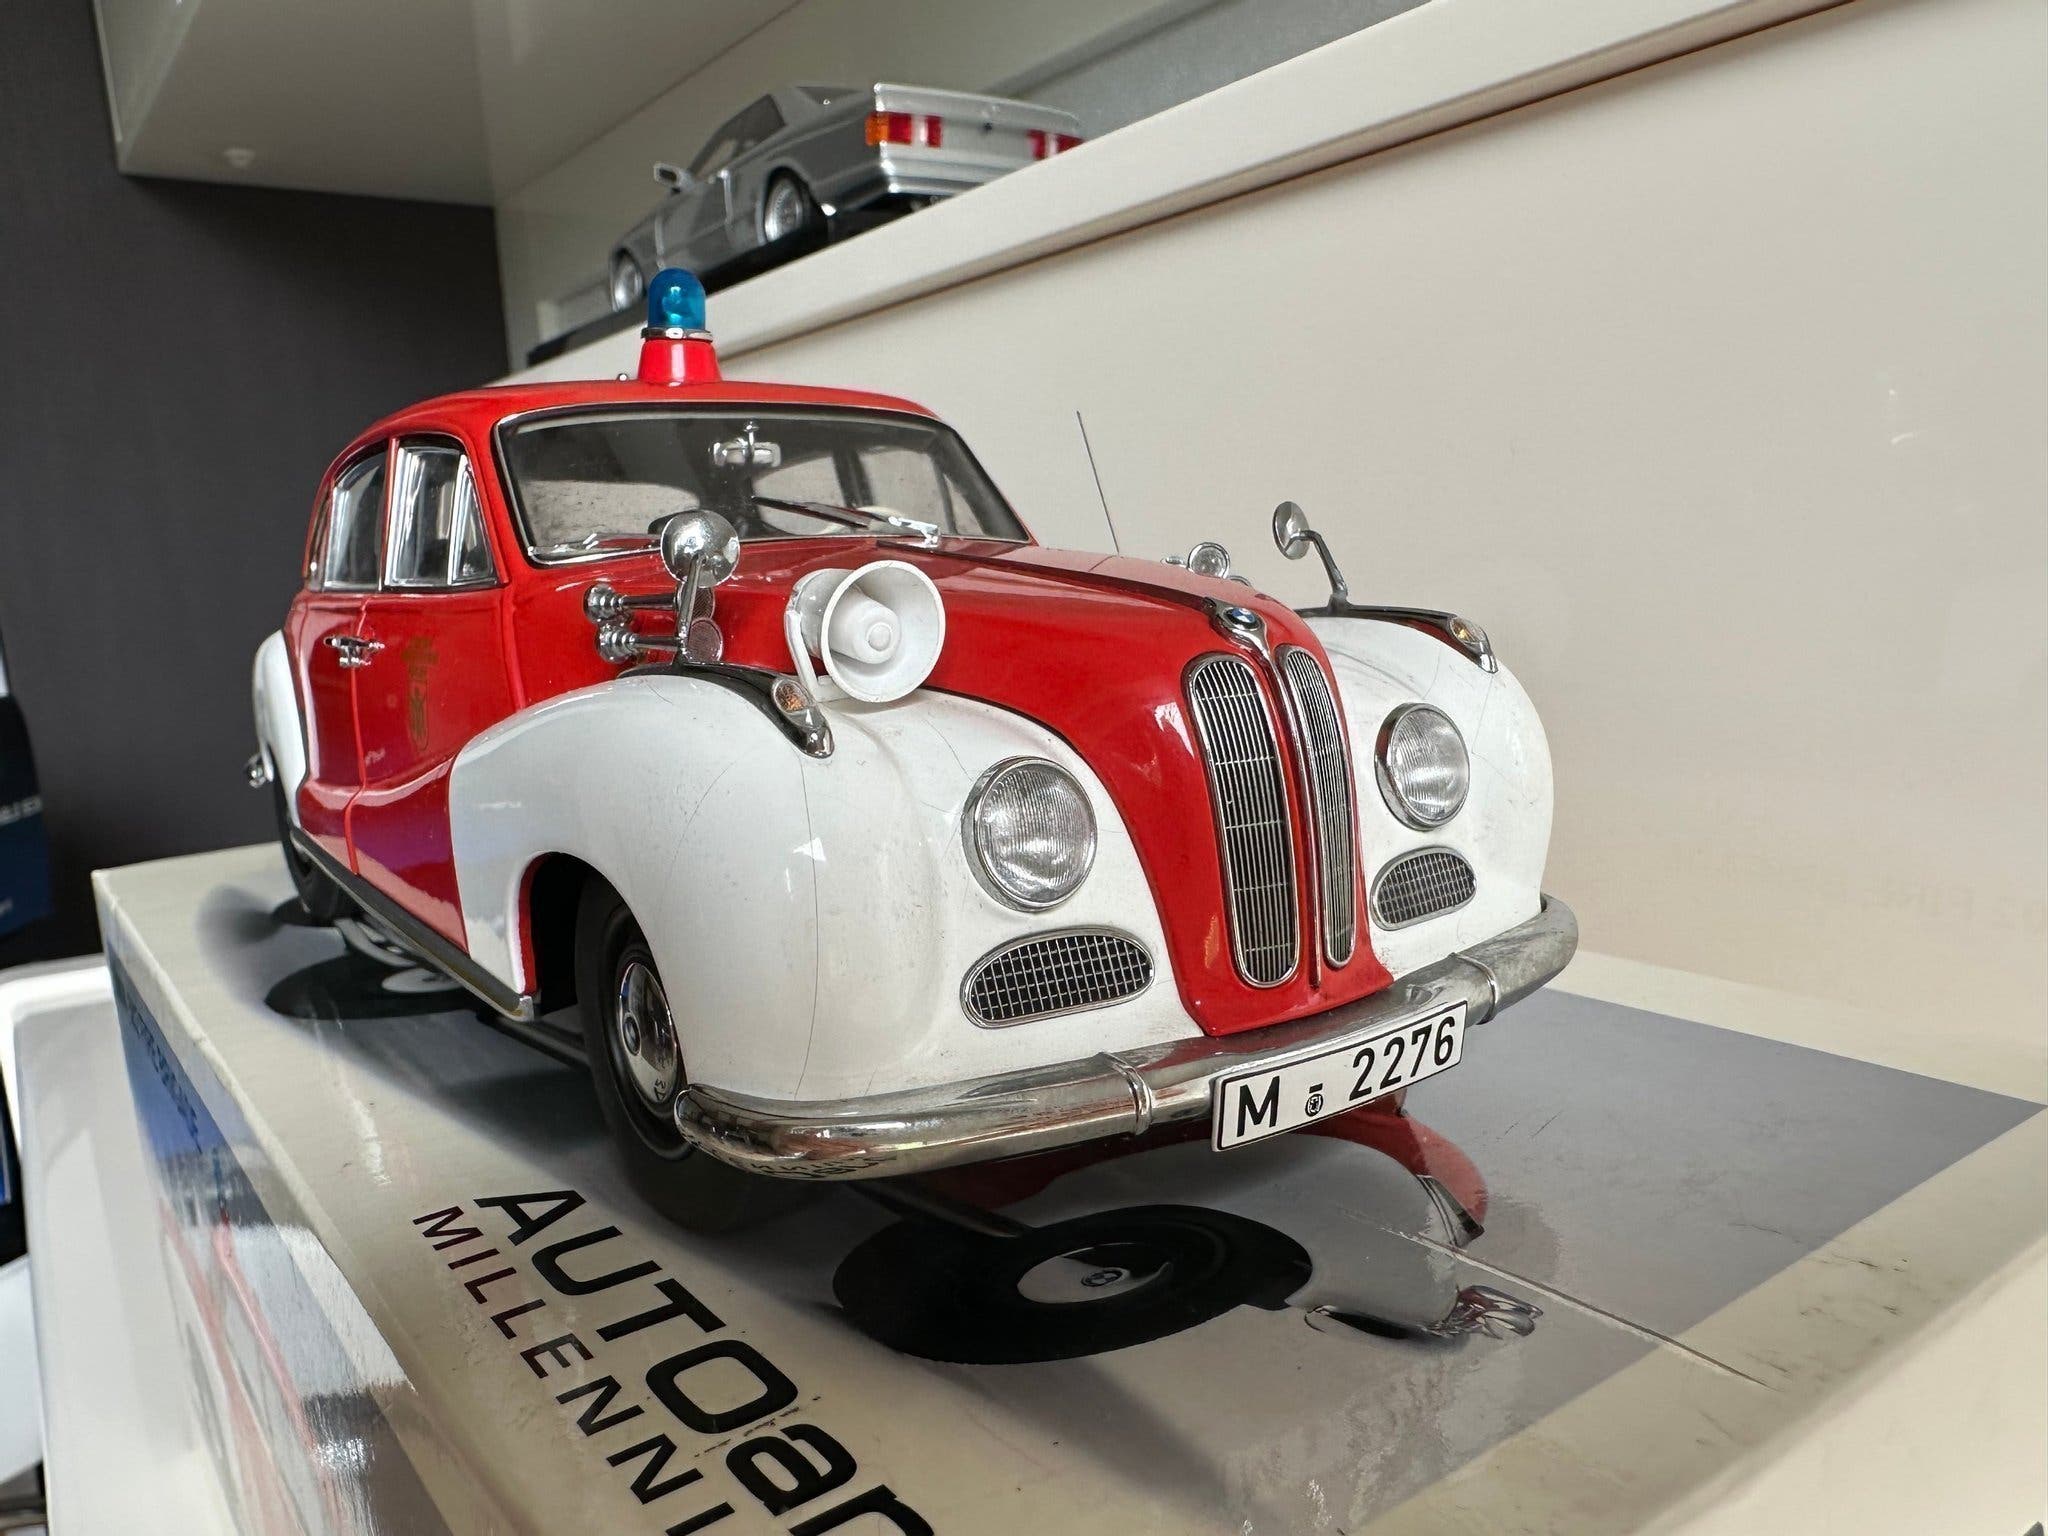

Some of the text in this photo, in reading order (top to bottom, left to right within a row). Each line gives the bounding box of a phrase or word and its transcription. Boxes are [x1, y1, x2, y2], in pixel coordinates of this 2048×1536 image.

[1236, 1075, 1281, 1138] M
[1349, 1016, 1456, 1101] 2276
[412, 1205, 736, 1536] MILLENNI
